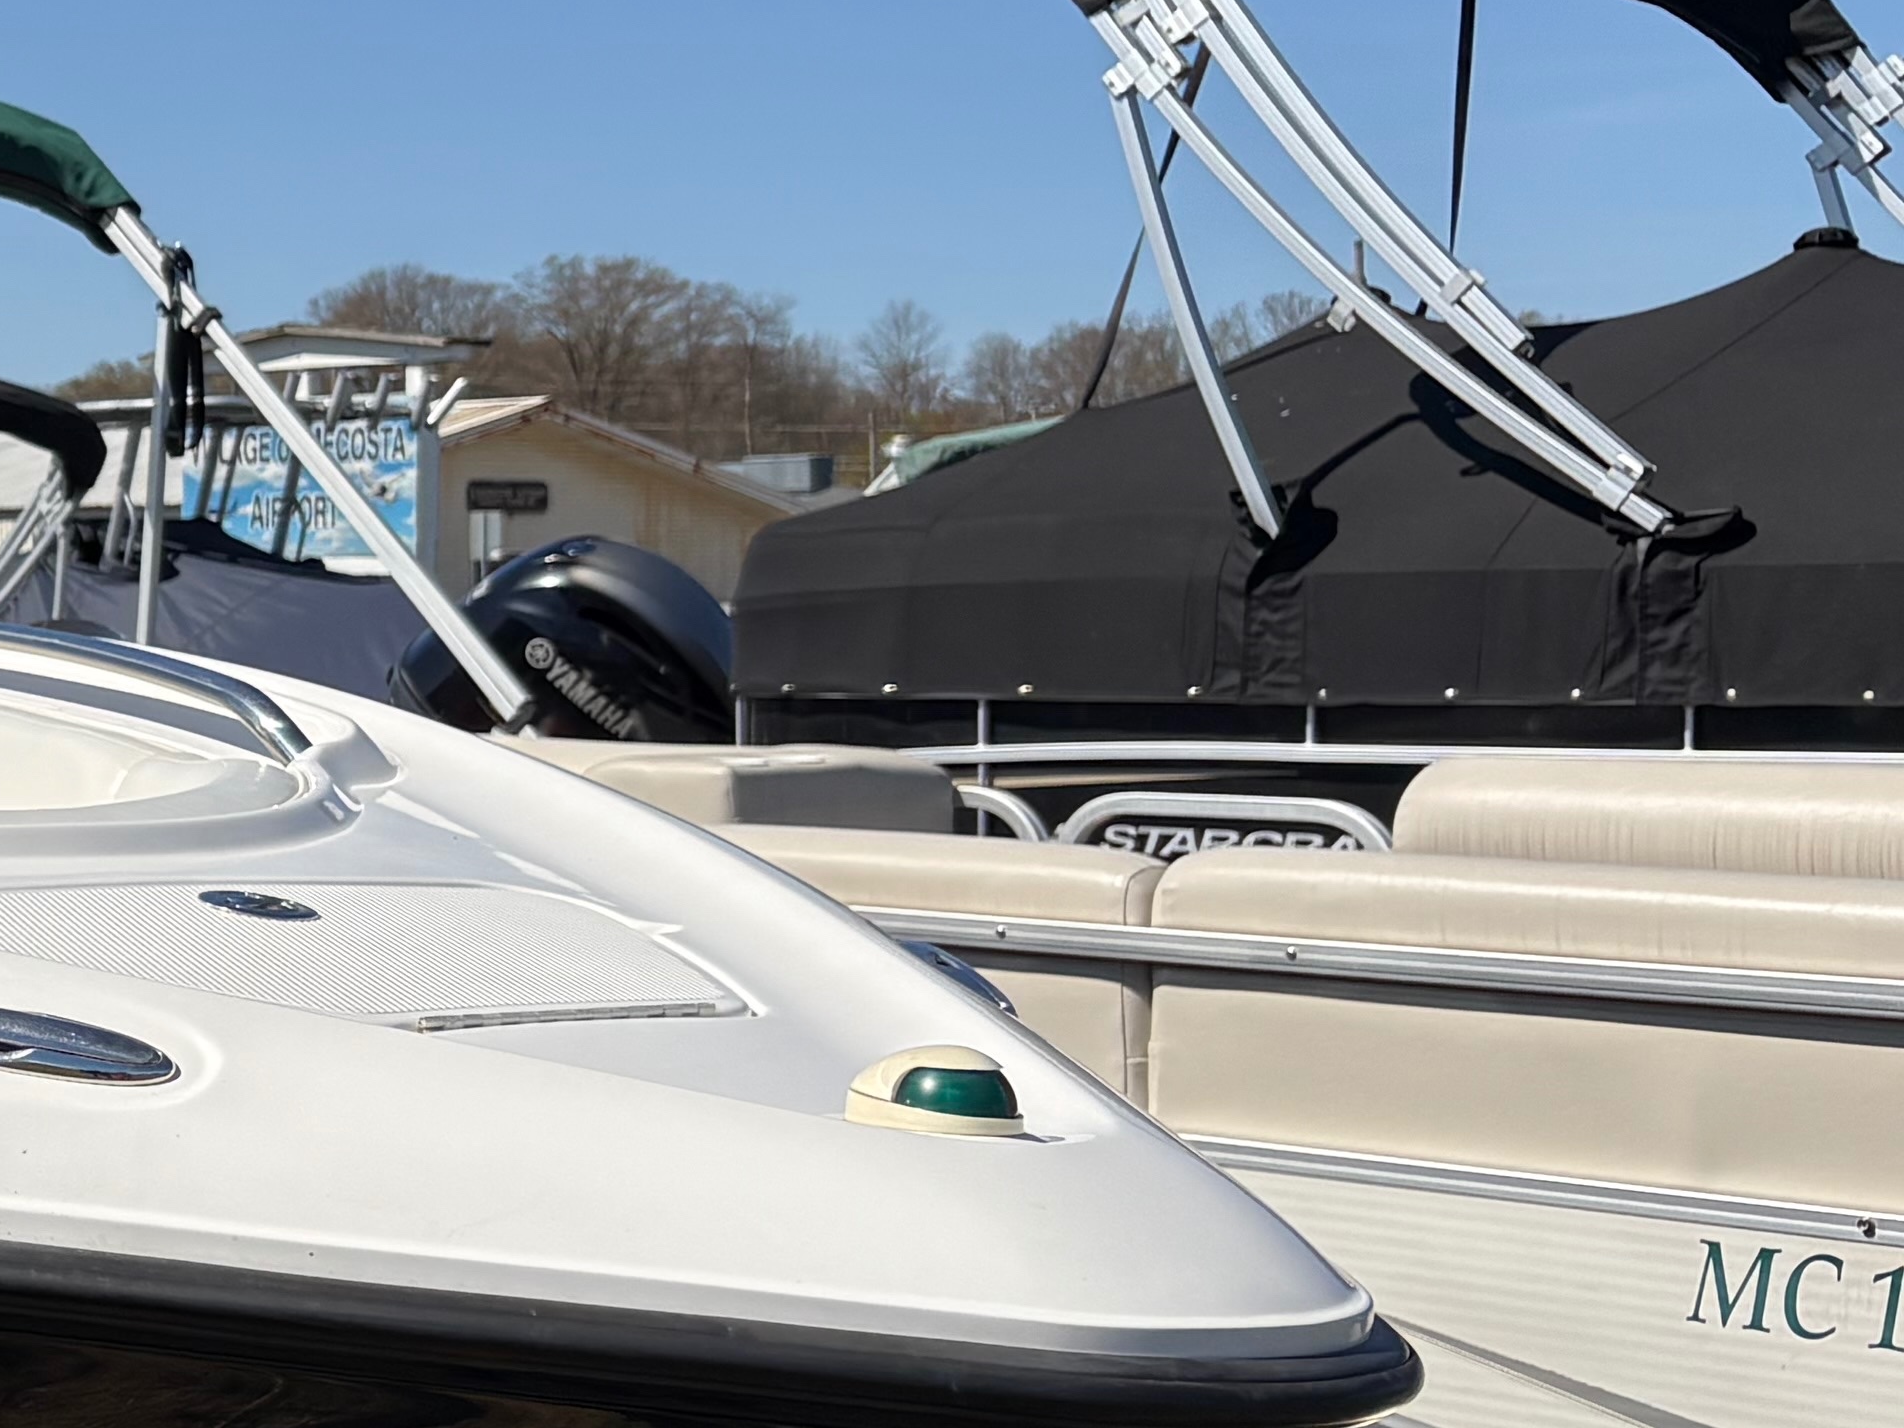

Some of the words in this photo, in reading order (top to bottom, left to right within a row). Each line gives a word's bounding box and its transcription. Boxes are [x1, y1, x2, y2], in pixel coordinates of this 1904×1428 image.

[315, 427, 406, 462] COSTA
[250, 494, 336, 529] AIRORT
[545, 657, 635, 739] YAMAHA
[1686, 1238, 1844, 1340] MC
[1867, 1265, 1904, 1353] 1
